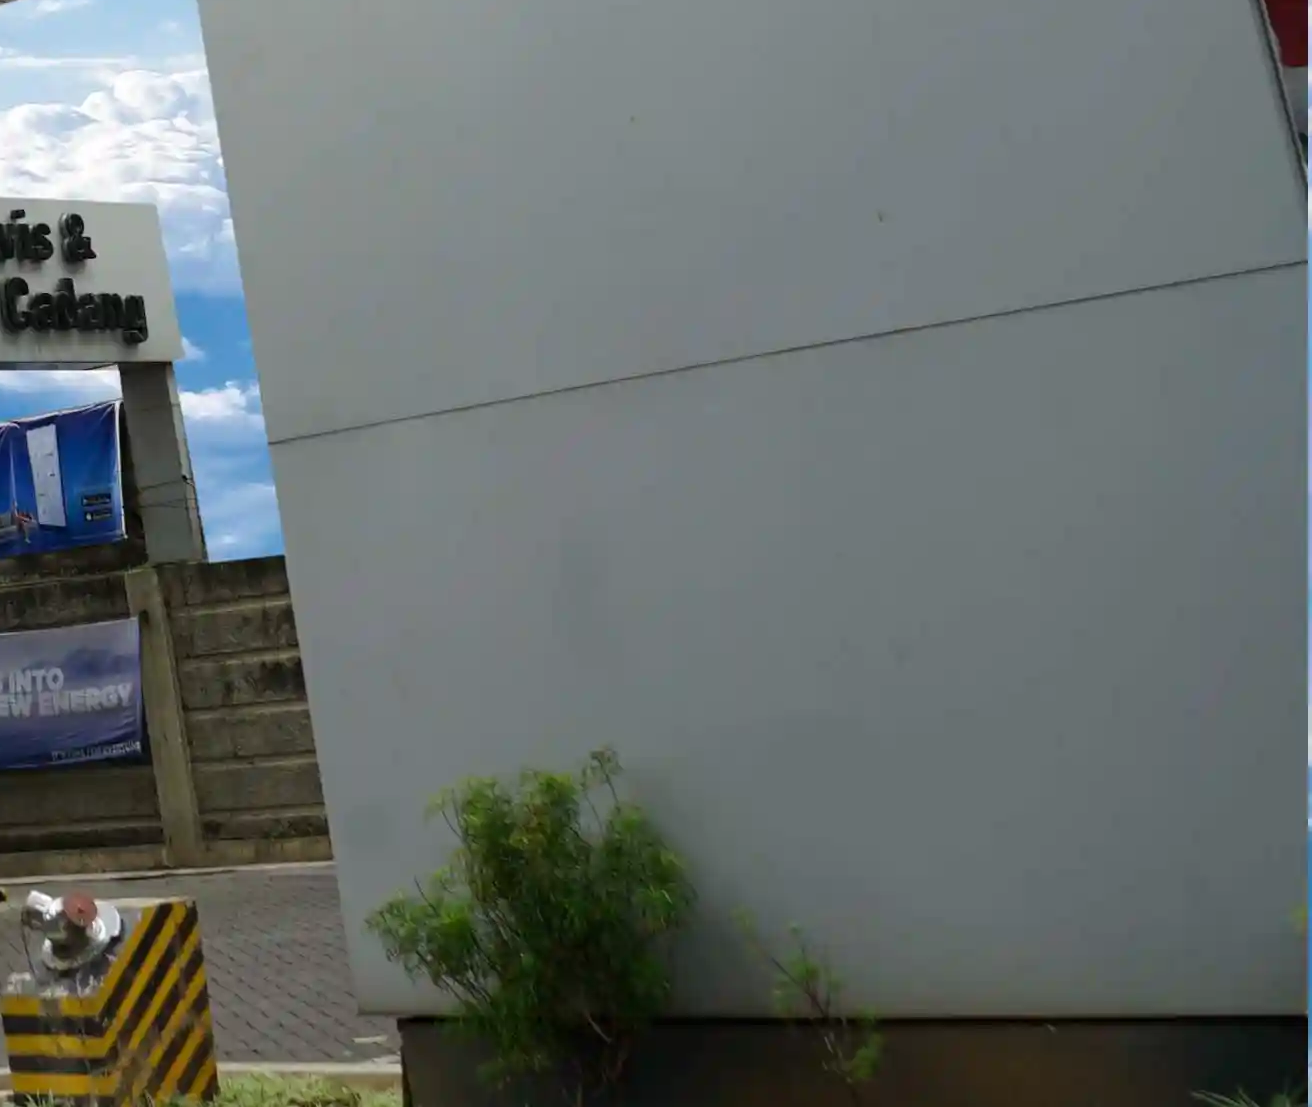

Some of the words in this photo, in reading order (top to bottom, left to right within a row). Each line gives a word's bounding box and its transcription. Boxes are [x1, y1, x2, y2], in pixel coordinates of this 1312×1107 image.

[59, 213, 97, 261] &
[8, 666, 65, 693] INTO
[37, 682, 134, 716] ENERGY
